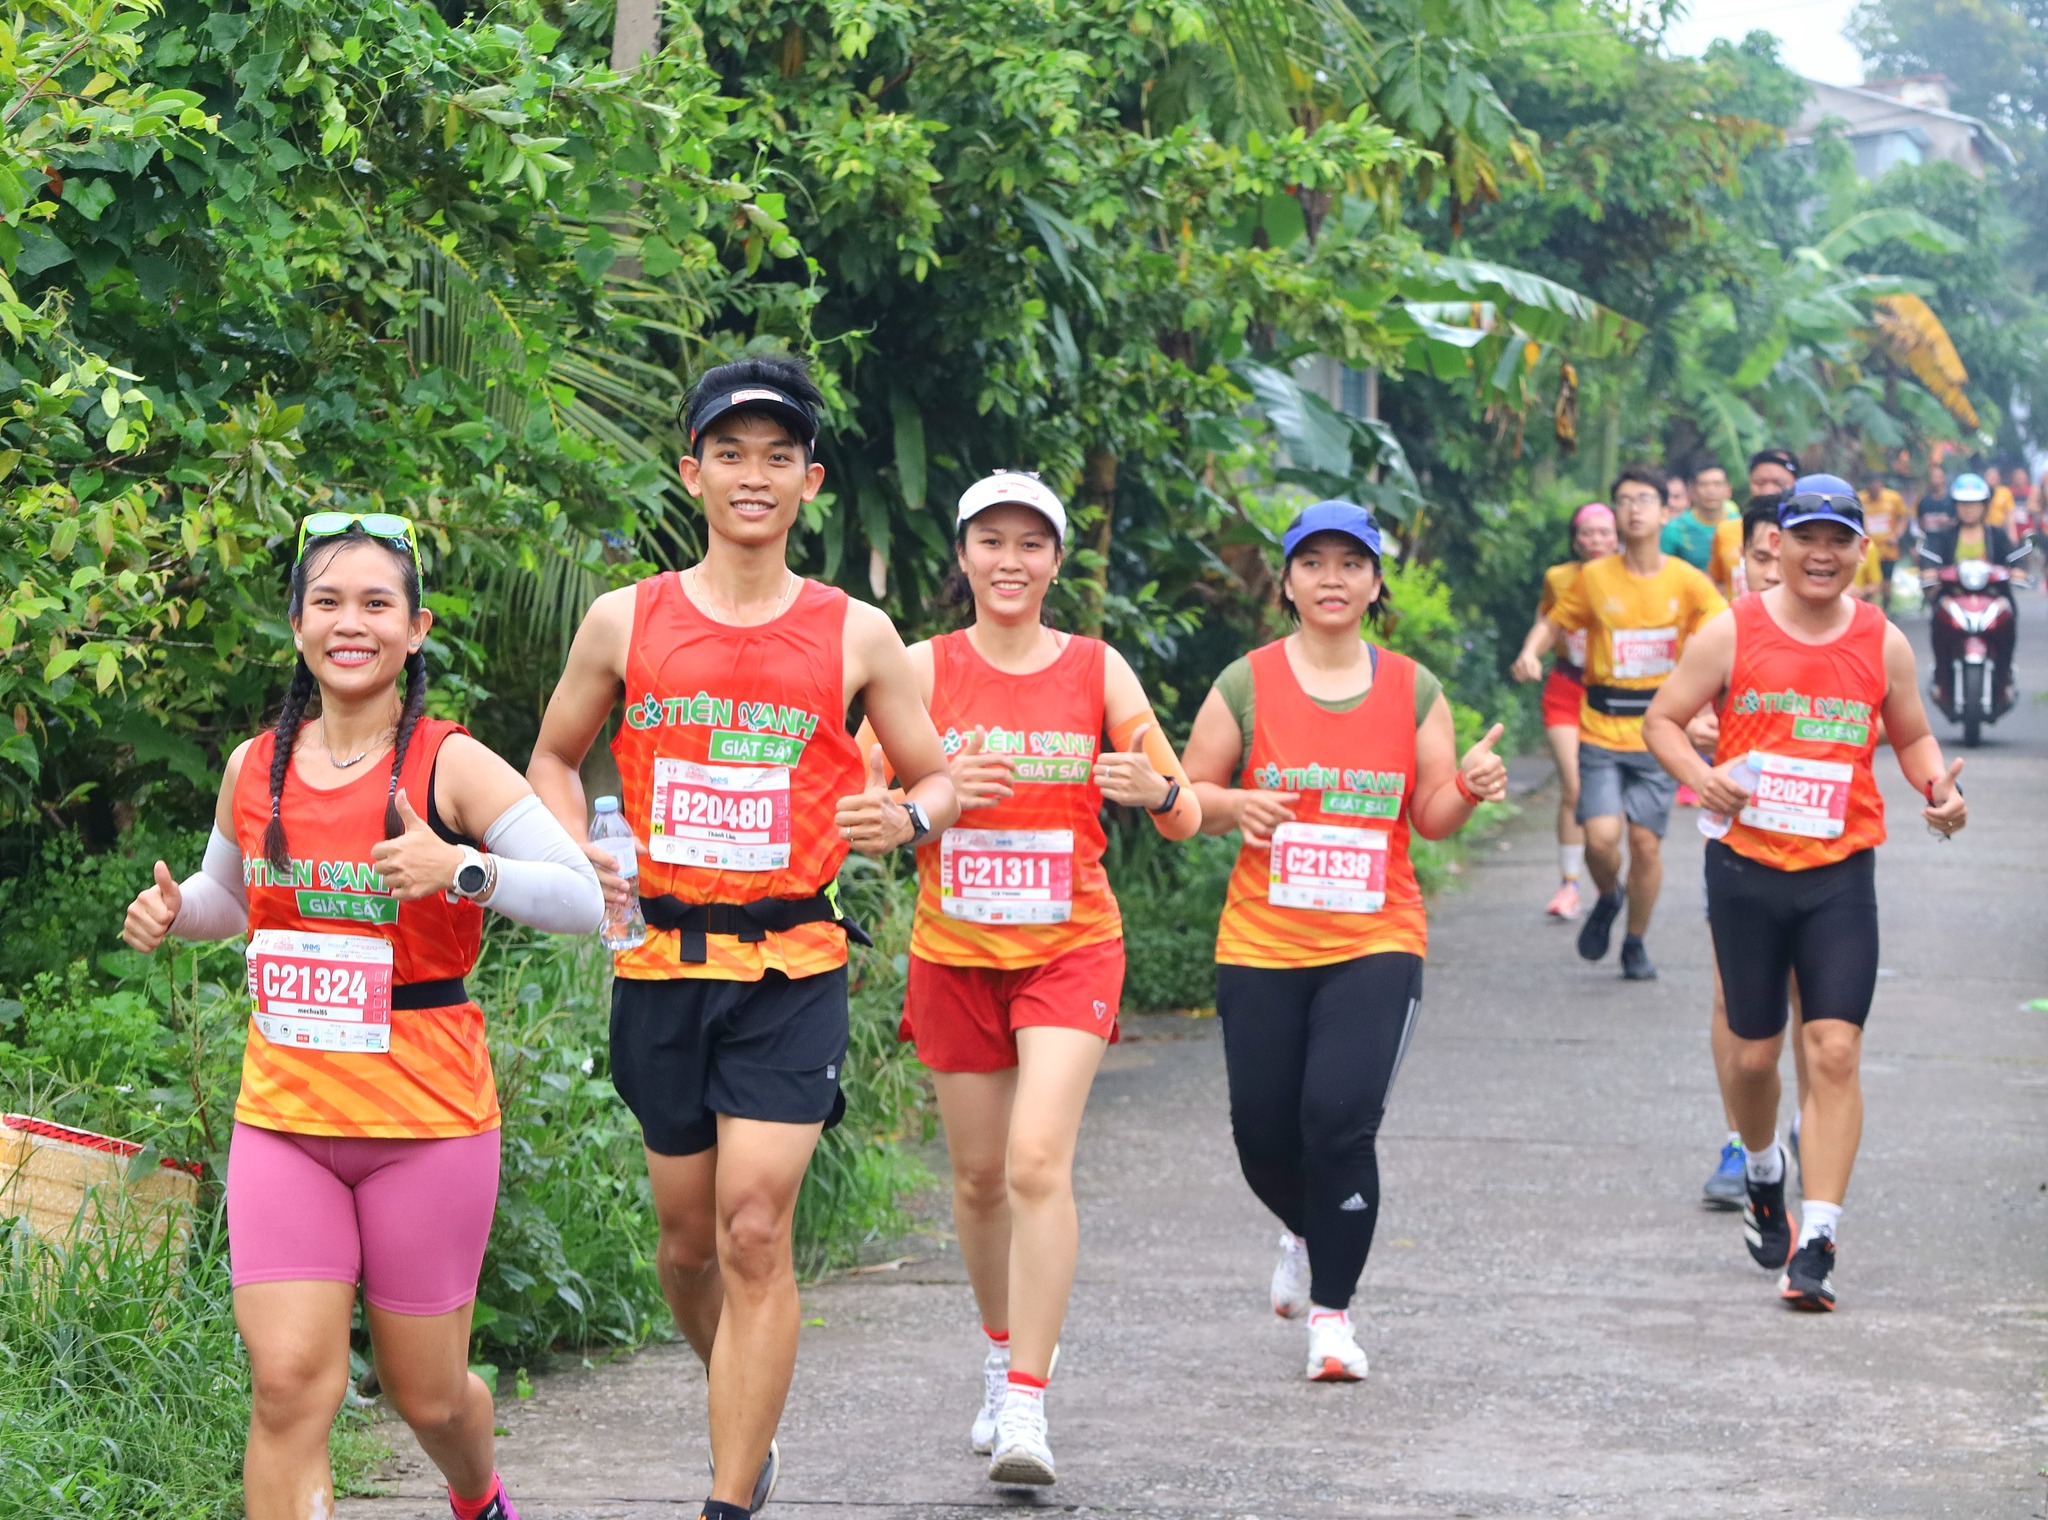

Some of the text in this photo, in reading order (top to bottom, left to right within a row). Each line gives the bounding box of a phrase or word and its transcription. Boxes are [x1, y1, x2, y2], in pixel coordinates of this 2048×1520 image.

[662, 691, 733, 727] TIÊN
[738, 701, 819, 740] XANH
[1760, 688, 1811, 716] TIÊN
[721, 738, 761, 760] GIẶT
[1029, 731, 1097, 757] XANH
[1281, 762, 1340, 790] TIÊN
[1343, 769, 1406, 795] XANH
[1757, 774, 1835, 807] B20217
[654, 785, 668, 819] 21KM
[672, 789, 773, 830] B20480
[654, 824, 663, 834] M
[958, 855, 1050, 887] C21311
[1286, 846, 1371, 879] C21338
[309, 896, 385, 918] GIẶT SẤY
[302, 943, 320, 951] VNMS
[262, 962, 368, 1005] C21324
